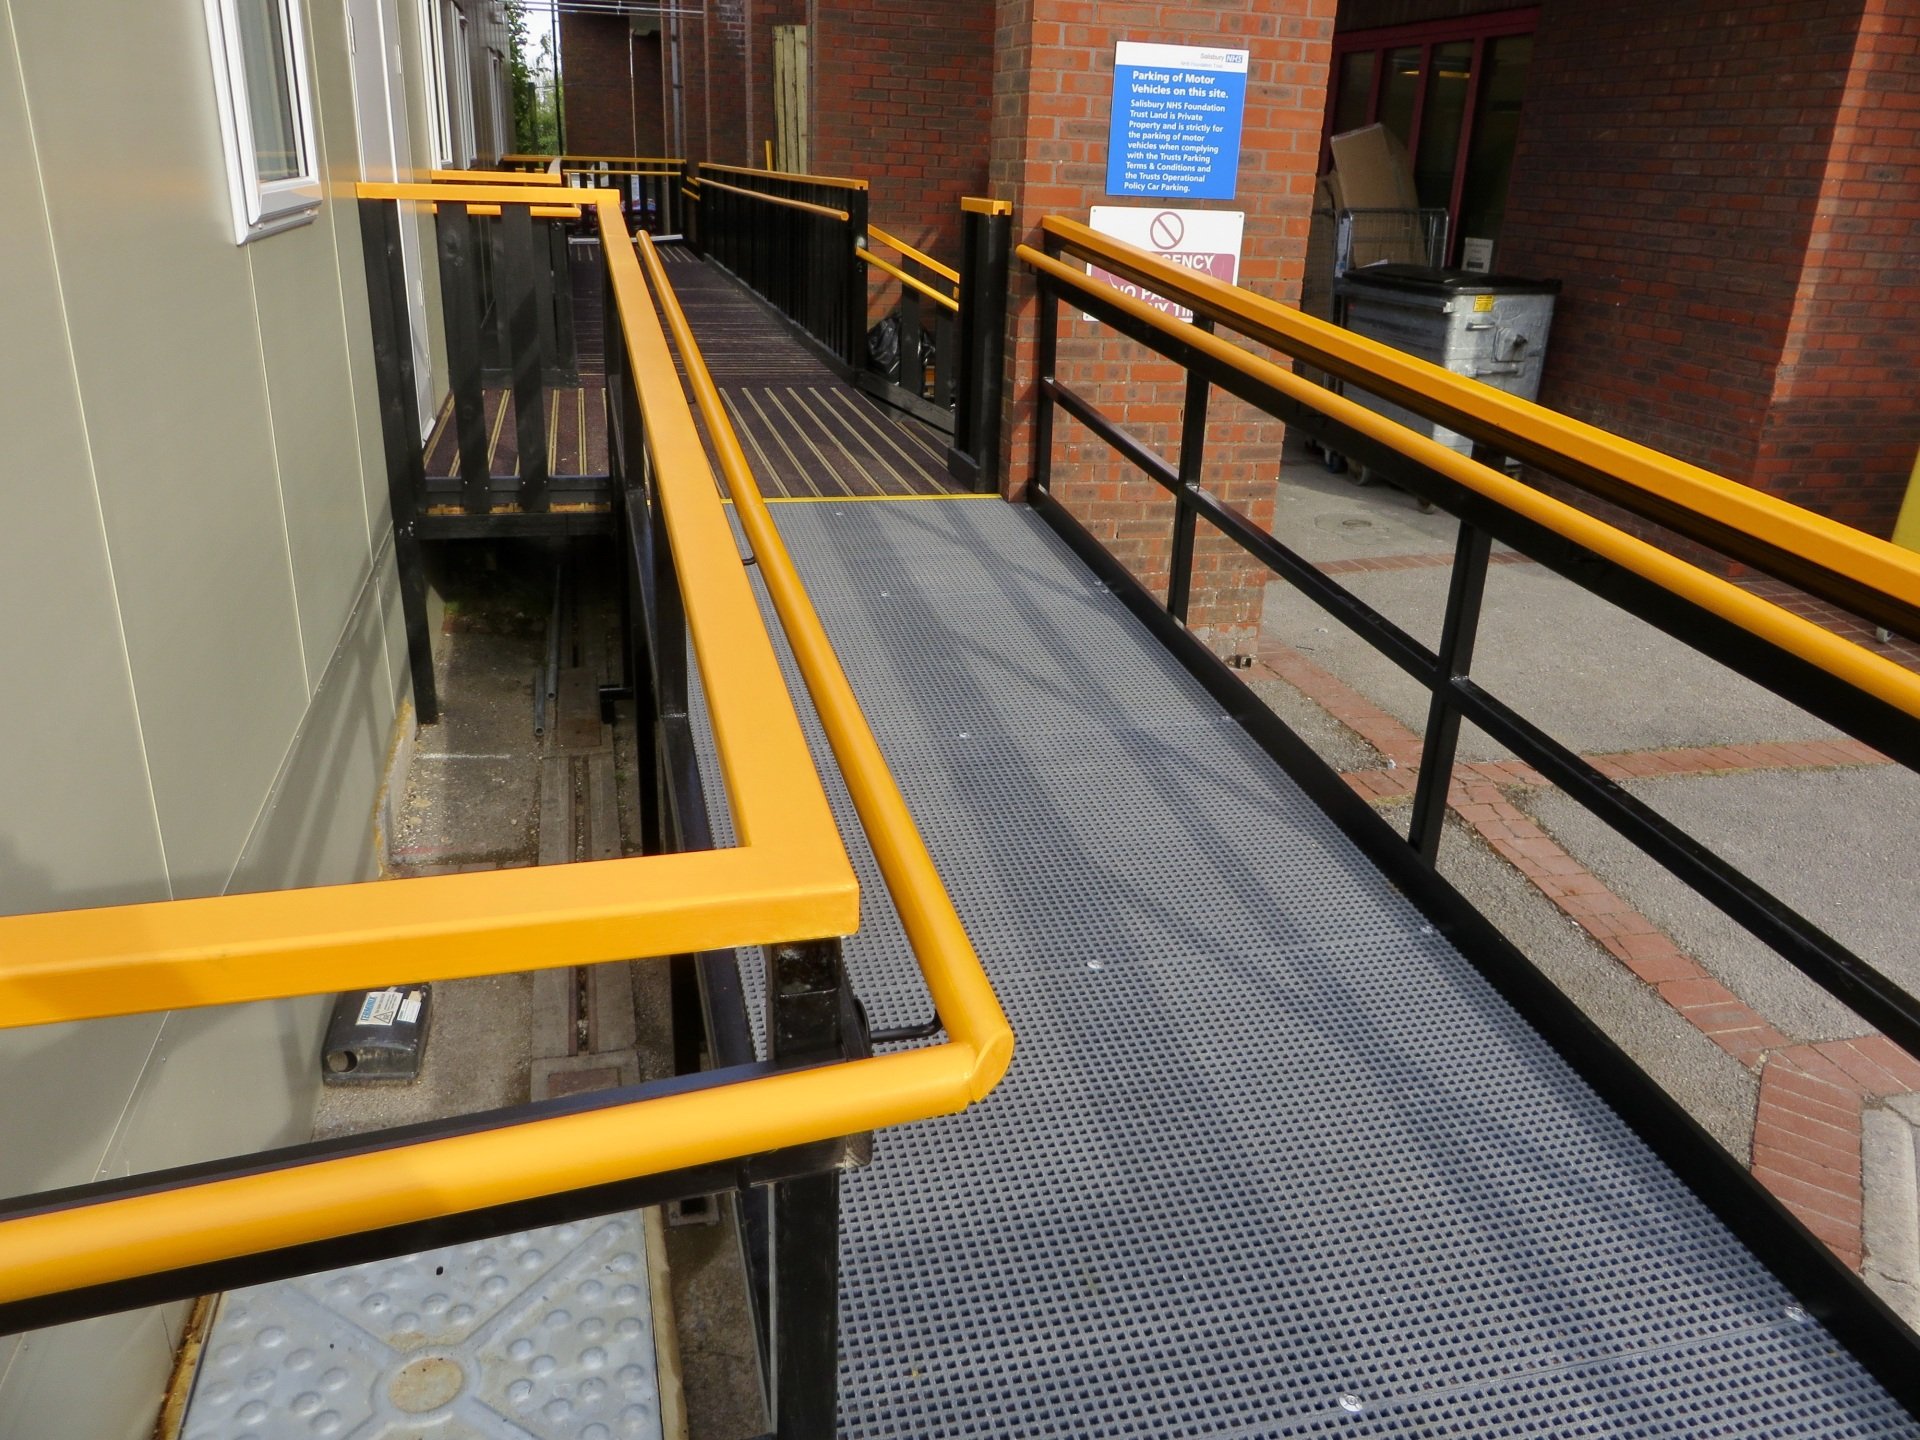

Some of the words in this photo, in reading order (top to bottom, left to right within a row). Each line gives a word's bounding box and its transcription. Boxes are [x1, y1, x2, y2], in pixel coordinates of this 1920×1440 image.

[1226, 54, 1242, 63] NHS
[1132, 71, 1169, 83] Parking
[1172, 73, 1182, 82] of
[1185, 74, 1215, 84] Motor
[1132, 84, 1170, 95] Vehicles
[1174, 87, 1185, 96] on
[1189, 87, 1206, 97] this
[1209, 88, 1228, 98] site.
[1130, 99, 1164, 109] Salisbury
[1184, 103, 1226, 112] Foundation
[1130, 110, 1148, 118] Trust
[1150, 111, 1168, 119] Land
[1170, 112, 1176, 120] is
[1178, 112, 1203, 121] Private
[1129, 121, 1160, 130] Property
[1162, 122, 1176, 130] and
[1186, 123, 1210, 133] strictly
[1212, 124, 1224, 132] for
[1142, 132, 1170, 142] parking
[1128, 142, 1156, 150] vehicles
[1159, 142, 1179, 150] when
[1182, 144, 1218, 154] complying
[1160, 153, 1181, 161] Trusts
[1184, 154, 1210, 164] Parking
[1157, 163, 1195, 172] Conditions
[1162, 174, 1205, 182] Operational
[1124, 182, 1145, 191] Policy
[1162, 184, 1190, 194] Parking.
